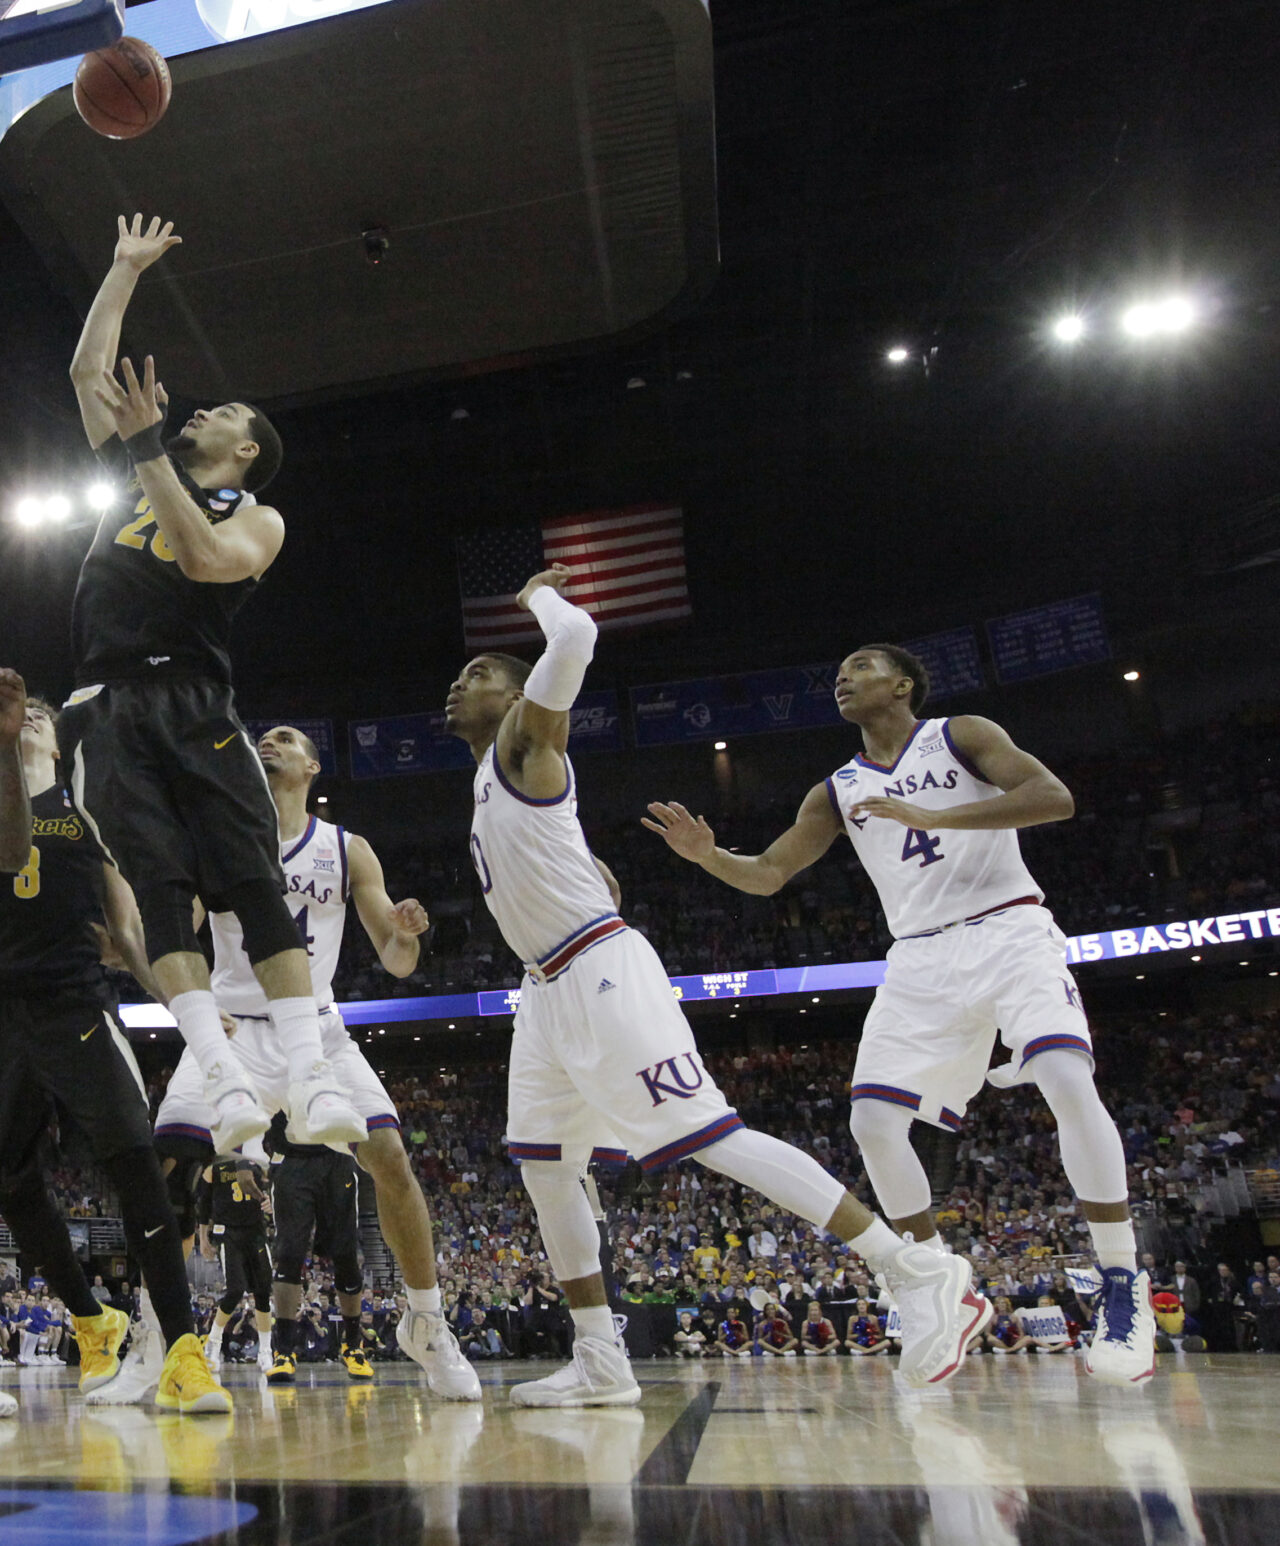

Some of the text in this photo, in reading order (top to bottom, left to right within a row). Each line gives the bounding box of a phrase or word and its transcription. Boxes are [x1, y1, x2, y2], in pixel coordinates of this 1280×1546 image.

[850, 769, 959, 831] KNSAS
[901, 827, 945, 868] 4
[14, 845, 40, 899] 3
[287, 873, 333, 904] SAS
[702, 972, 748, 984] WICH ST
[635, 1052, 703, 1108] KU
